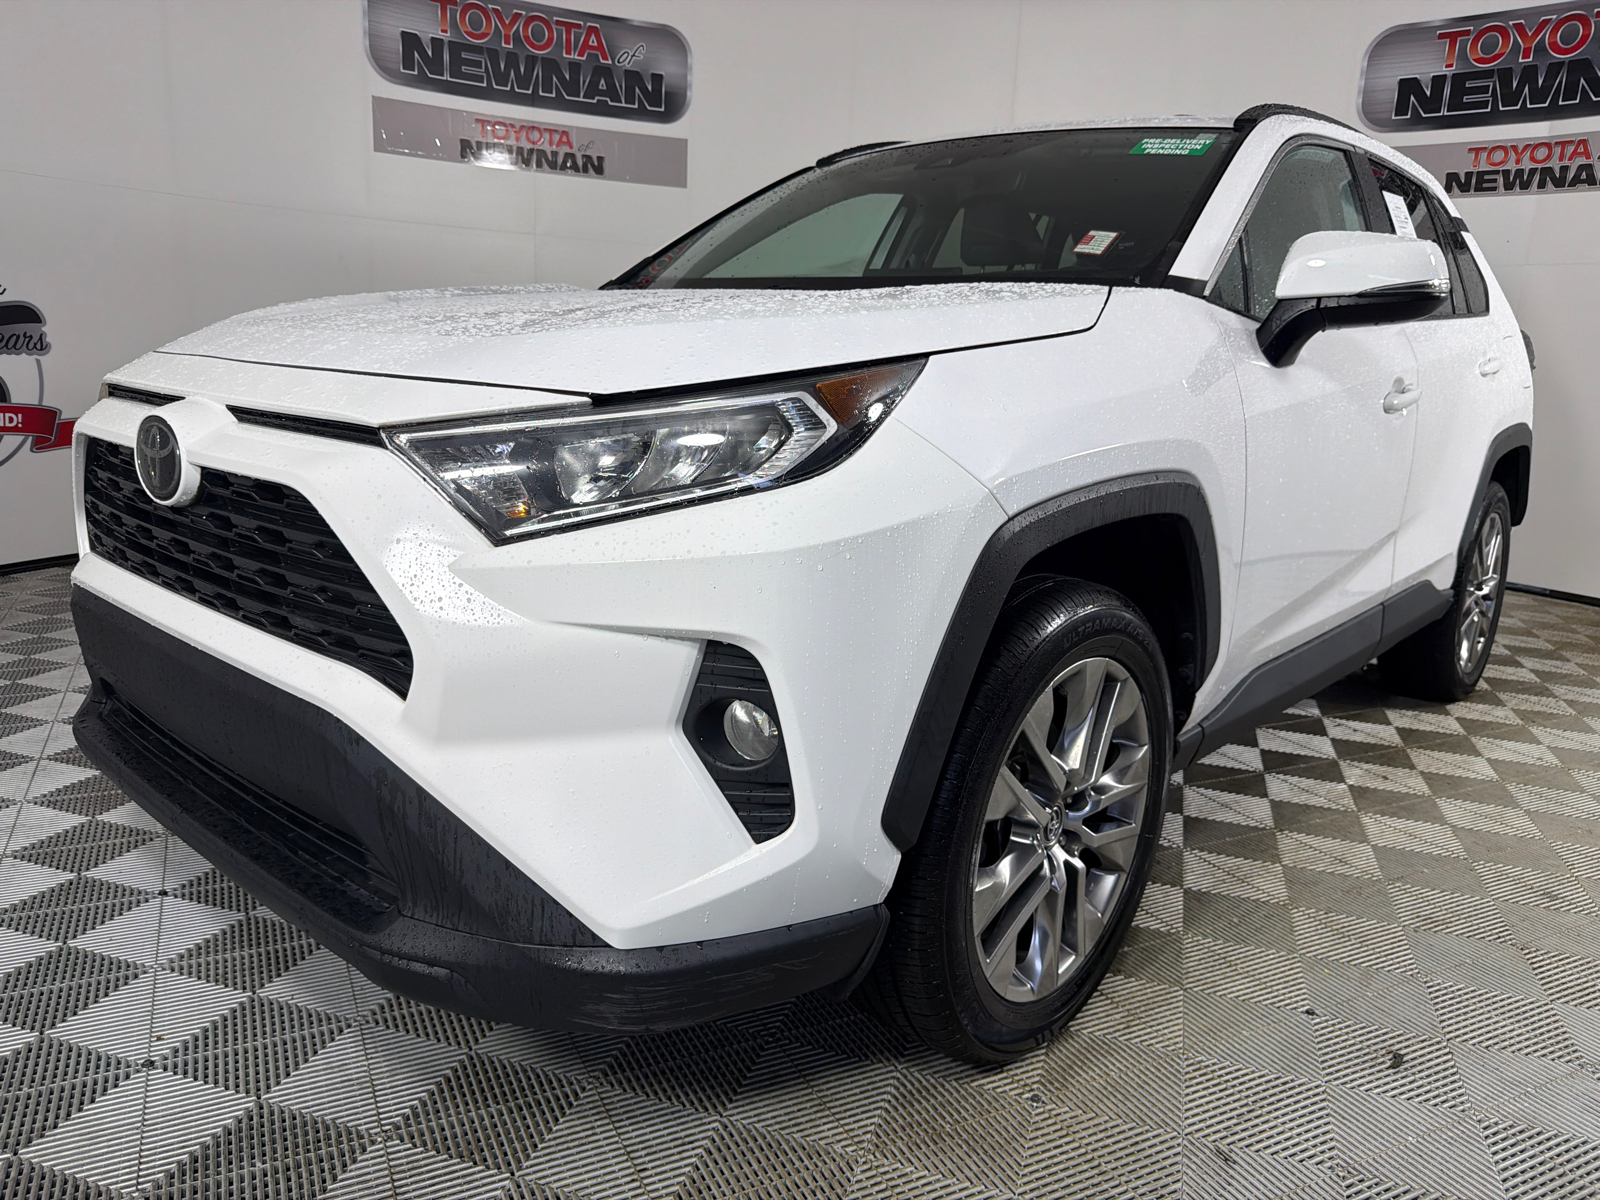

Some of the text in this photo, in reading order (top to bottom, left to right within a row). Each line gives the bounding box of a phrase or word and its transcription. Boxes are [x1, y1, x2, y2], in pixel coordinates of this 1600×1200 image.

[430, 0, 646, 66] TOYOTA of
[1437, 9, 1600, 70] TOYO
[400, 31, 665, 111] NEWNAN
[474, 117, 574, 150] TOYOTA
[1467, 138, 1593, 168] TOYOTA
[1444, 163, 1600, 194] NEWNA
